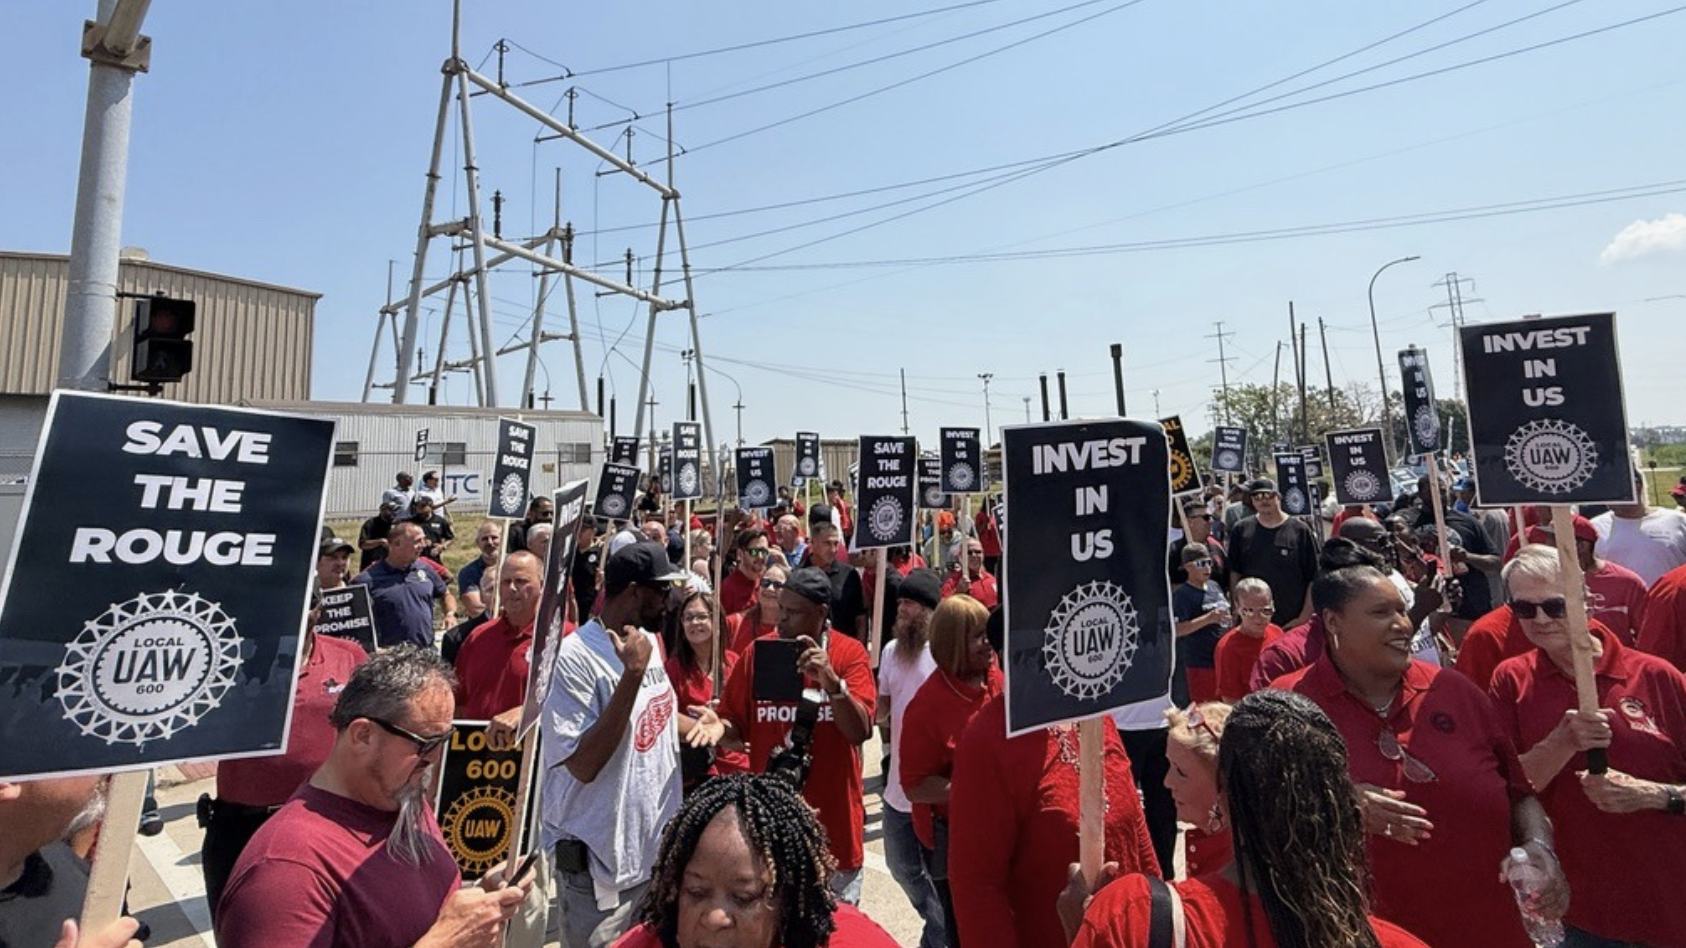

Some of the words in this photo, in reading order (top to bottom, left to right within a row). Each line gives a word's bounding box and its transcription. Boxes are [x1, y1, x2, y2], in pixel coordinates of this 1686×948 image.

[1483, 326, 1591, 353] INVEST
[1523, 359, 1556, 378] IN
[1416, 387, 1427, 398] US
[1522, 387, 1565, 406] US
[508, 426, 529, 440] SAVE
[1333, 434, 1374, 445] INVEST
[121, 421, 272, 463] SAVE
[510, 441, 525, 453] THE
[874, 442, 905, 454] SAVE
[740, 450, 769, 458] INVEST
[1032, 437, 1146, 475] INVEST
[1349, 446, 1363, 455] IN
[1530, 447, 1570, 465] UAW
[501, 454, 529, 469] ROUGE
[877, 459, 900, 471] THE
[1349, 456, 1367, 466] US
[750, 469, 762, 477] US
[867, 475, 907, 488] ROUGE
[134, 474, 246, 512] THE
[1075, 485, 1108, 516] IN
[69, 528, 276, 565] ROUGE
[1071, 529, 1114, 562] US
[326, 606, 352, 618] THE
[314, 617, 370, 633] PROMISE
[1081, 616, 1108, 628] LOCAL
[133, 637, 184, 648] LOCAL
[1073, 623, 1115, 656] UAW
[112, 646, 199, 685] UAW
[1087, 653, 1103, 663] 600
[136, 684, 165, 695] 600
[757, 706, 834, 722] PROSE
[465, 760, 517, 779] 600
[464, 820, 501, 838] UAW
